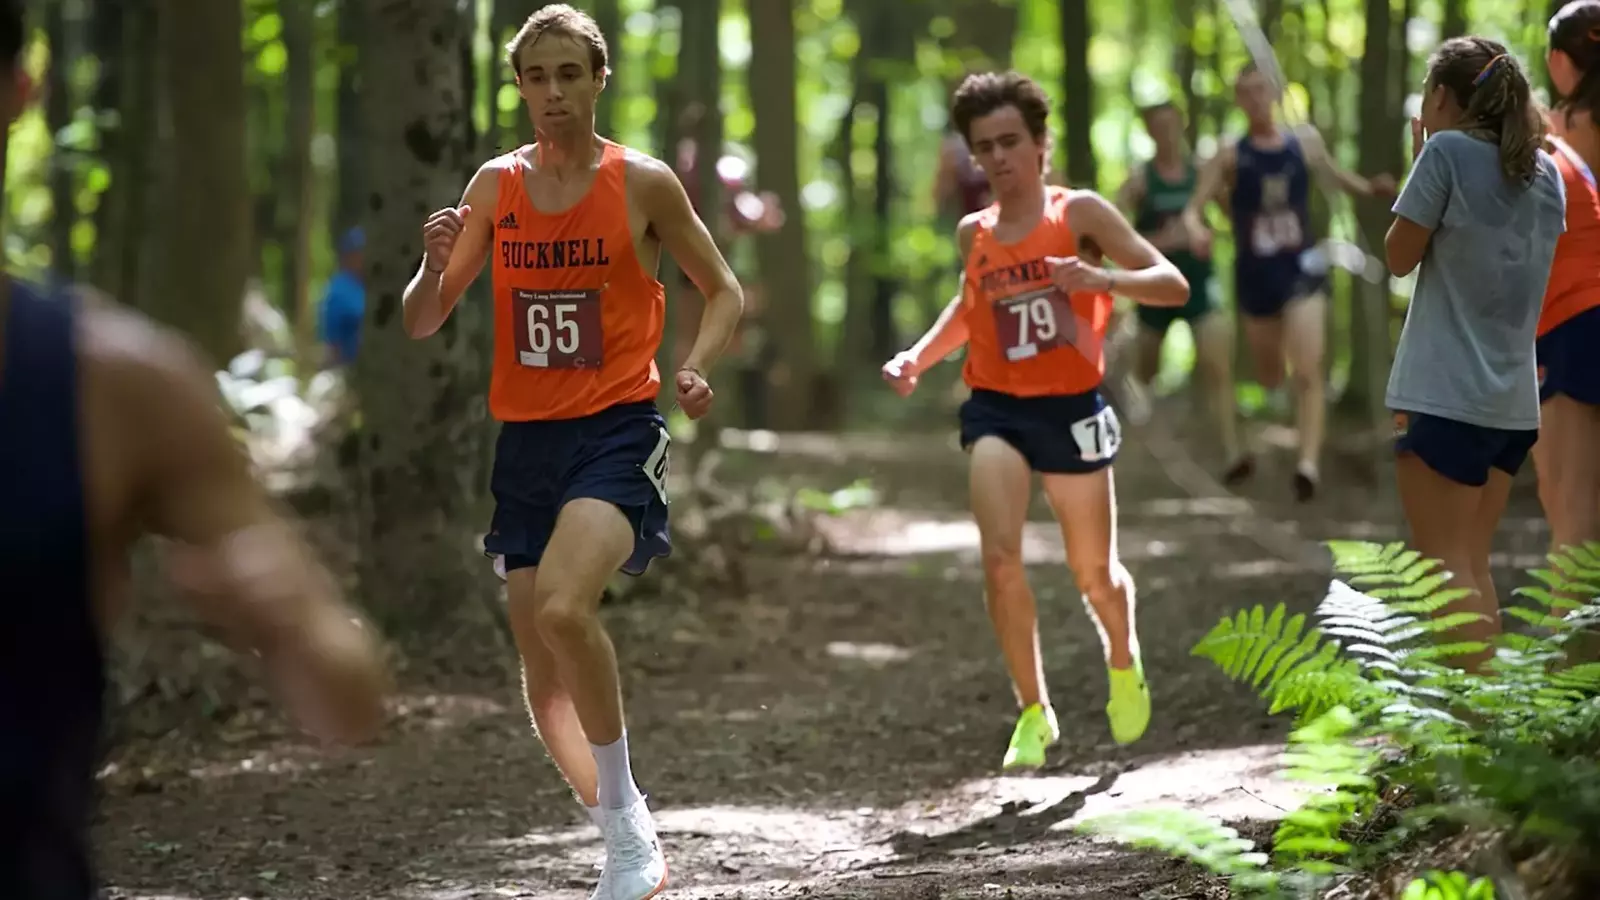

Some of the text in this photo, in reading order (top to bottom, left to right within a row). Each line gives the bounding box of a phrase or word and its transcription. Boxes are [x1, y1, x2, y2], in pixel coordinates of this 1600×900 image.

[502, 238, 609, 269] BUCKNELL
[527, 304, 580, 354] 65
[1009, 297, 1057, 346] 79
